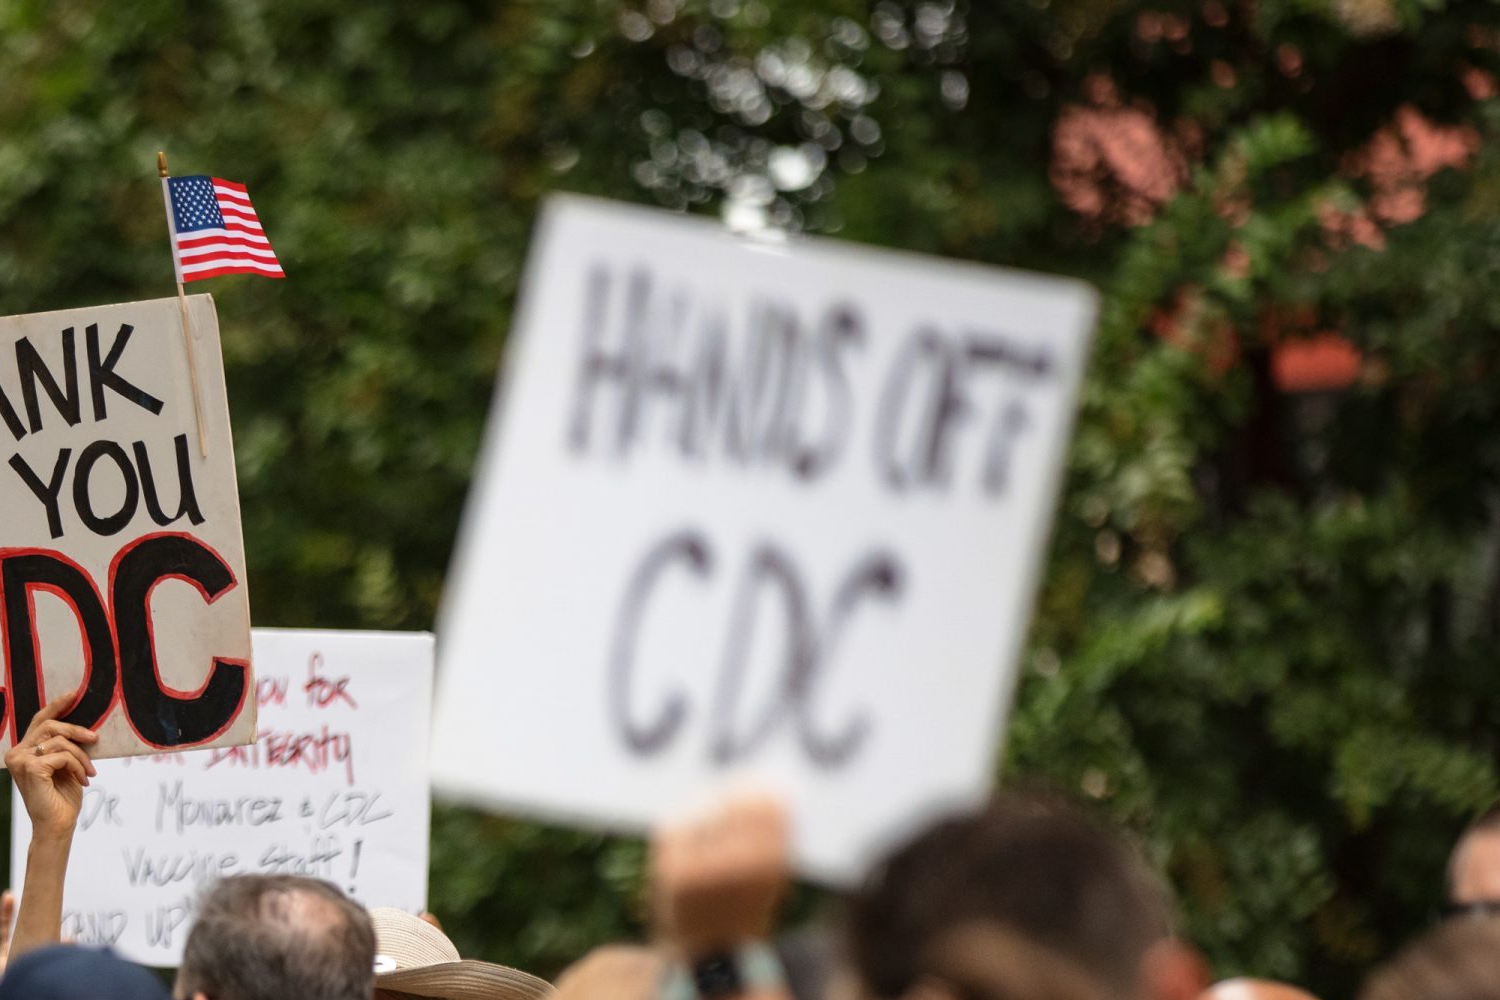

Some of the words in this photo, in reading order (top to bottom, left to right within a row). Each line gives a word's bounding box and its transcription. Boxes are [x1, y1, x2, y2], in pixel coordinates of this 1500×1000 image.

[564, 256, 867, 485] HANDS
[873, 323, 1056, 500] OFF
[8, 433, 205, 539] YOU
[605, 528, 908, 772] CDC
[318, 791, 395, 830] CDC
[62, 908, 129, 946] AND
